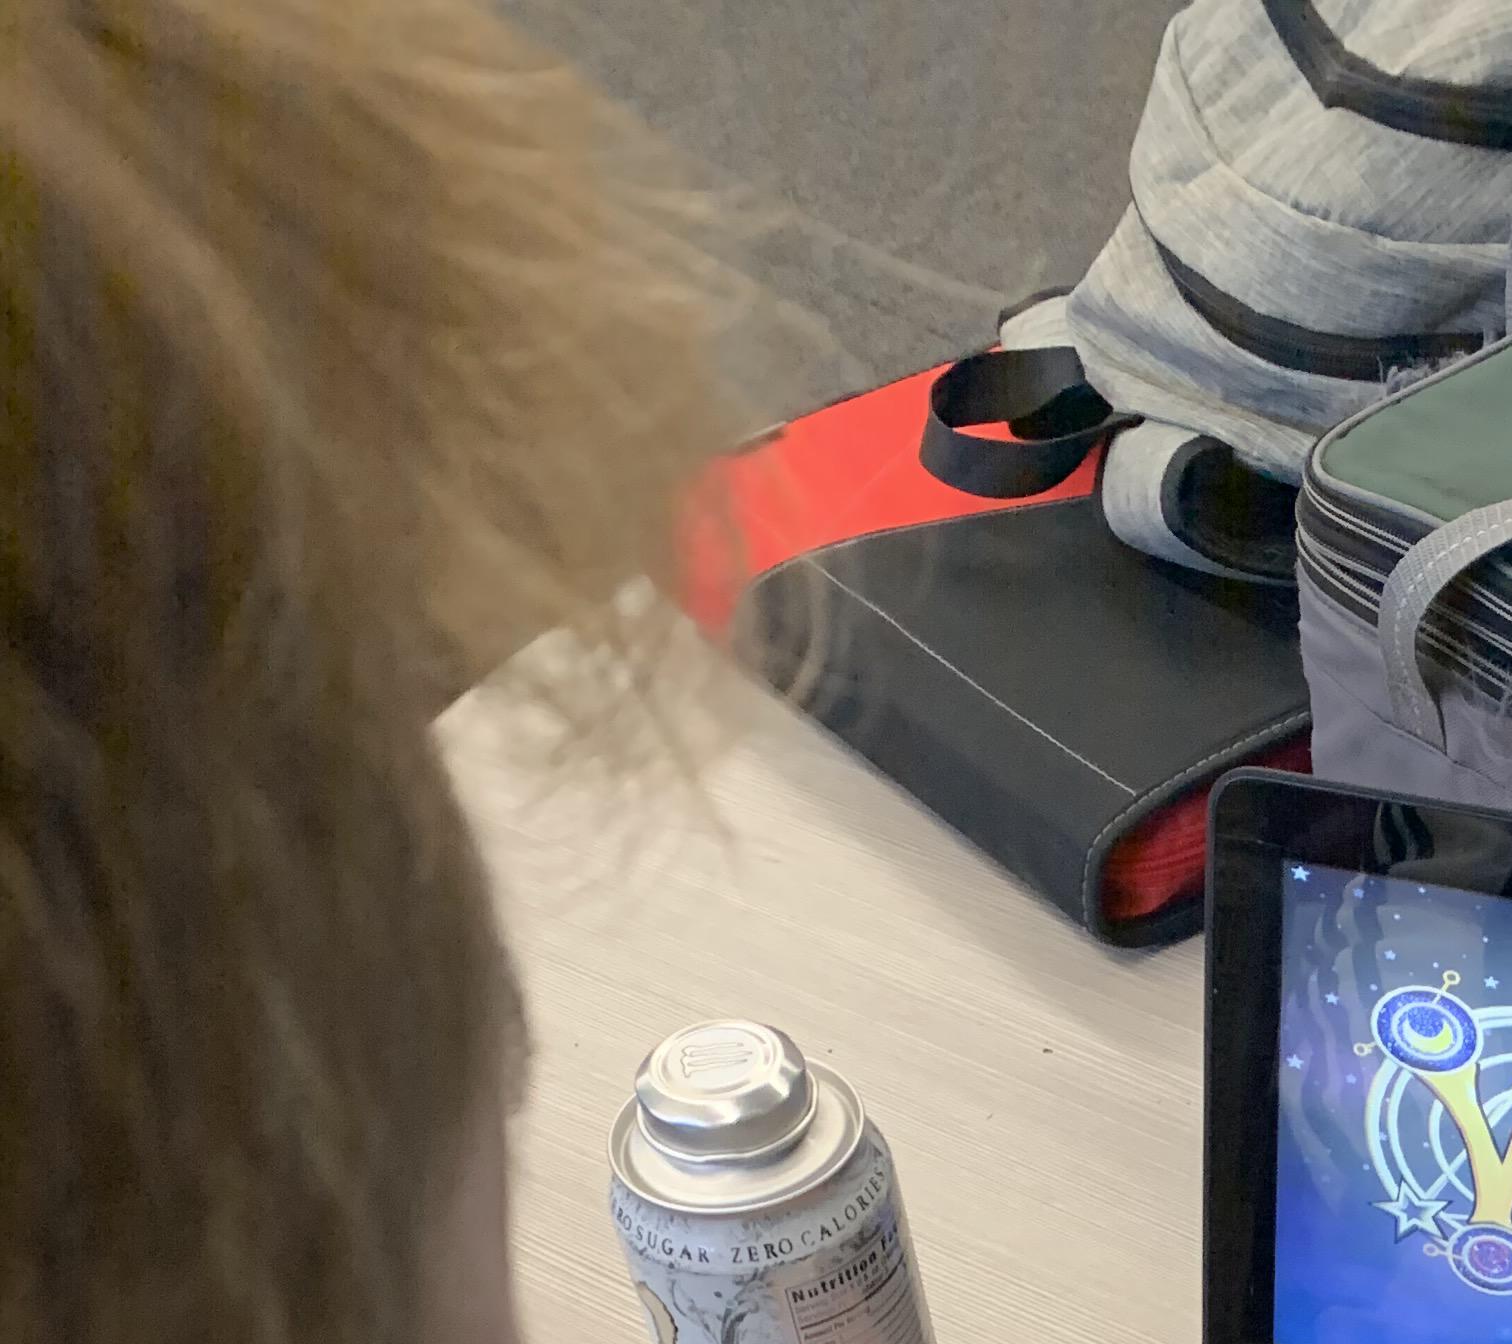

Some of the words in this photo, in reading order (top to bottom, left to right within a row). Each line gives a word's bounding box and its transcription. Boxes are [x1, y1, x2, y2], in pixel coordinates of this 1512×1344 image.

[635, 1224, 710, 1263] SUGAR
[731, 1237, 794, 1264] ZERO
[800, 1166, 886, 1247] CALORIES
[791, 1250, 878, 1303] Nutrition
